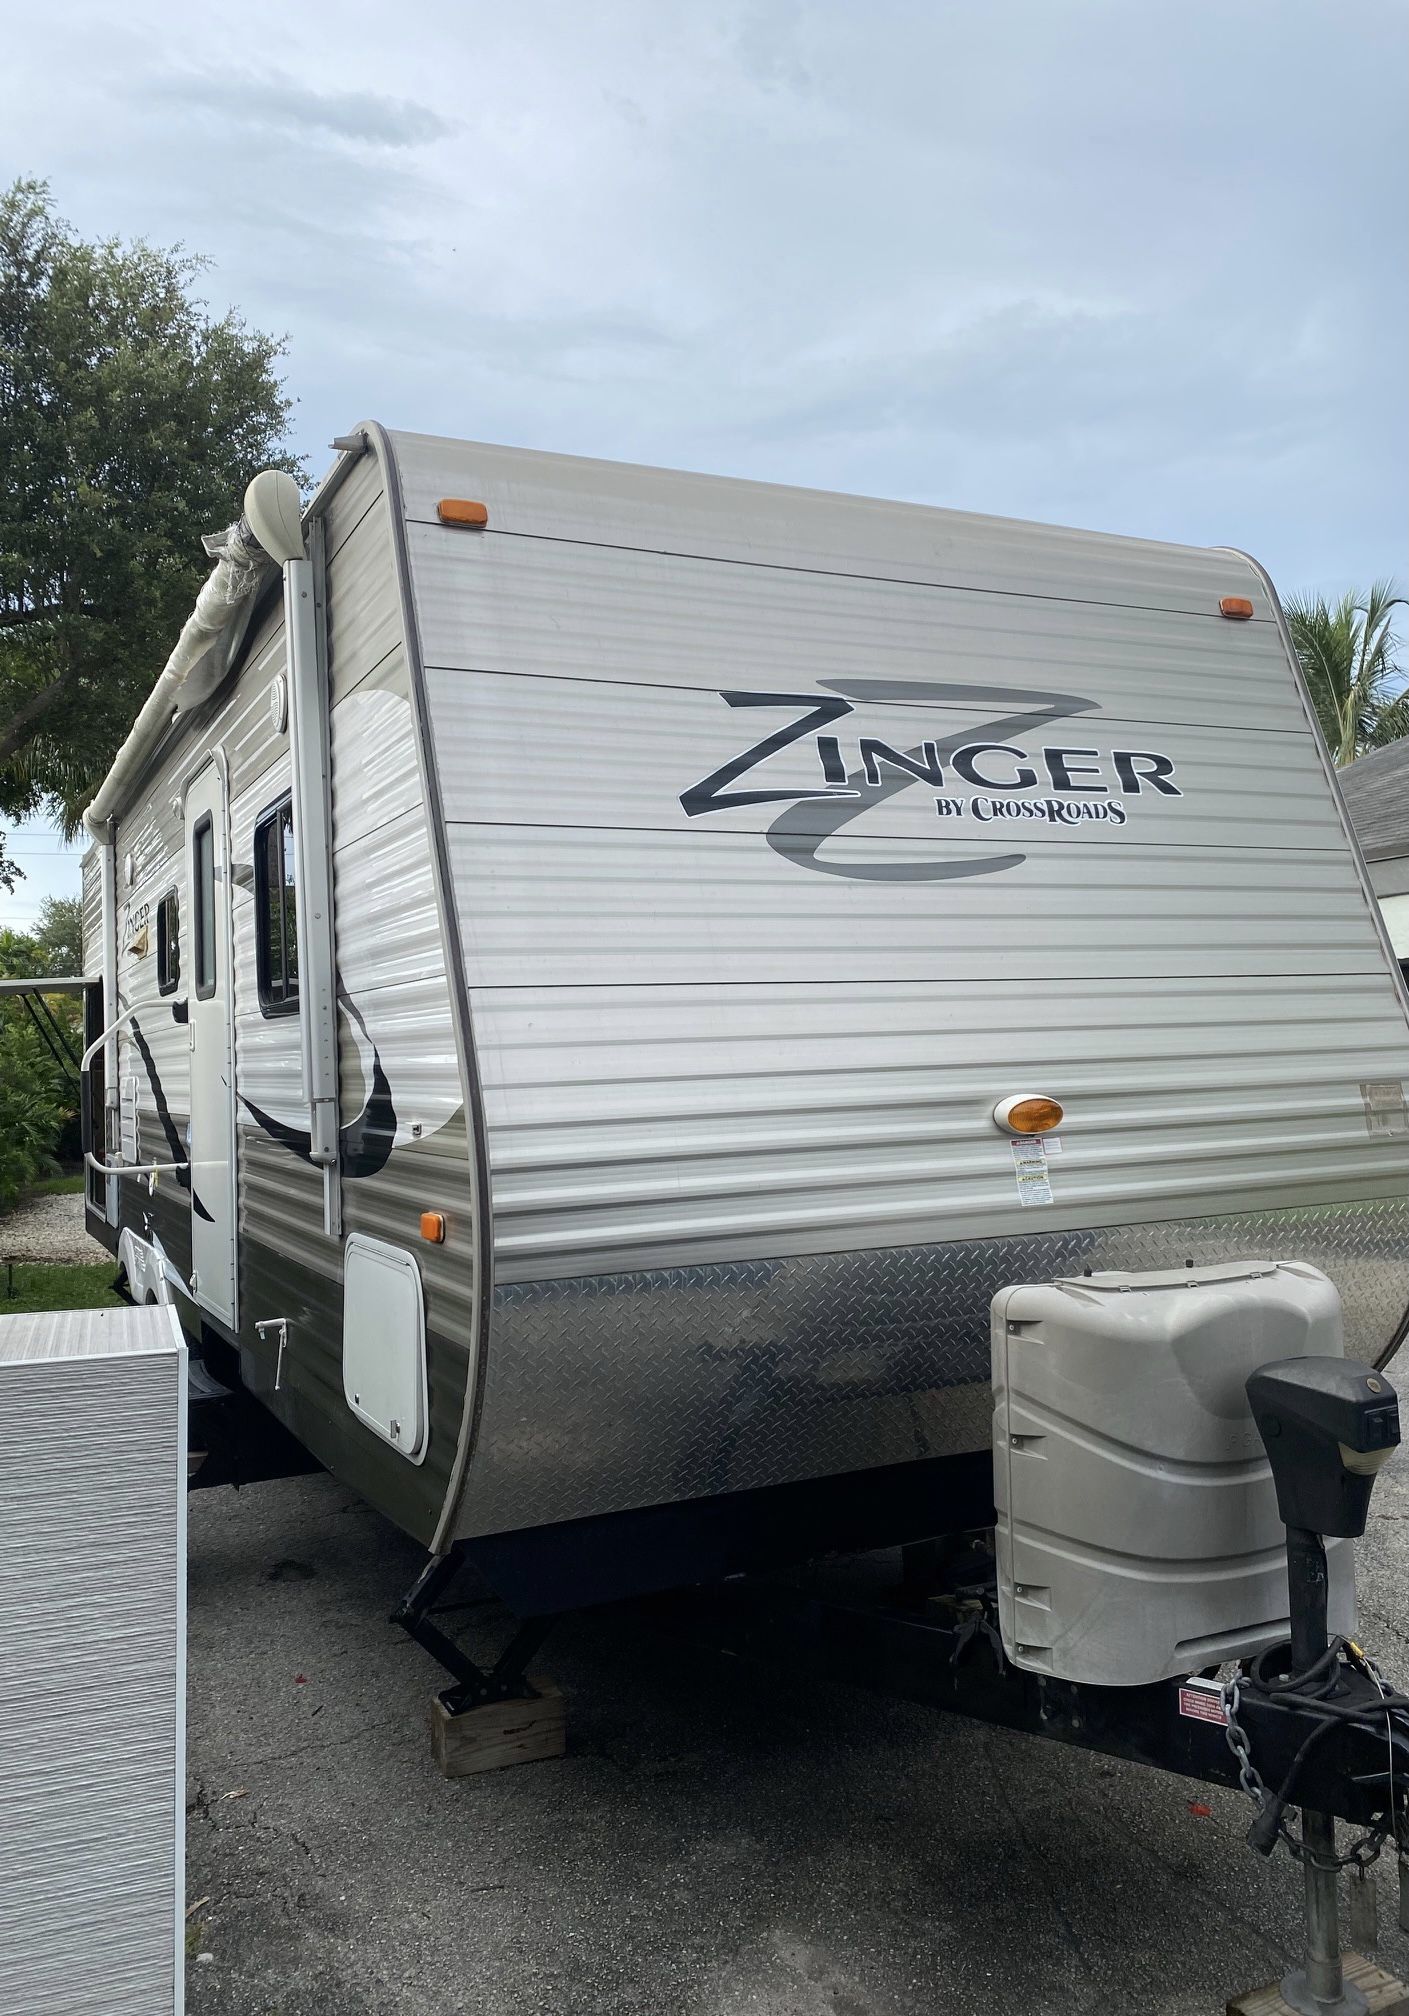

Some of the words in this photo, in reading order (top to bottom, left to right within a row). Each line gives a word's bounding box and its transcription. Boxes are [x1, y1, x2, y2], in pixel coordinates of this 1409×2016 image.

[678, 691, 1182, 818] ZINGER
[936, 797, 965, 819] BY
[122, 902, 150, 957] ZINGER
